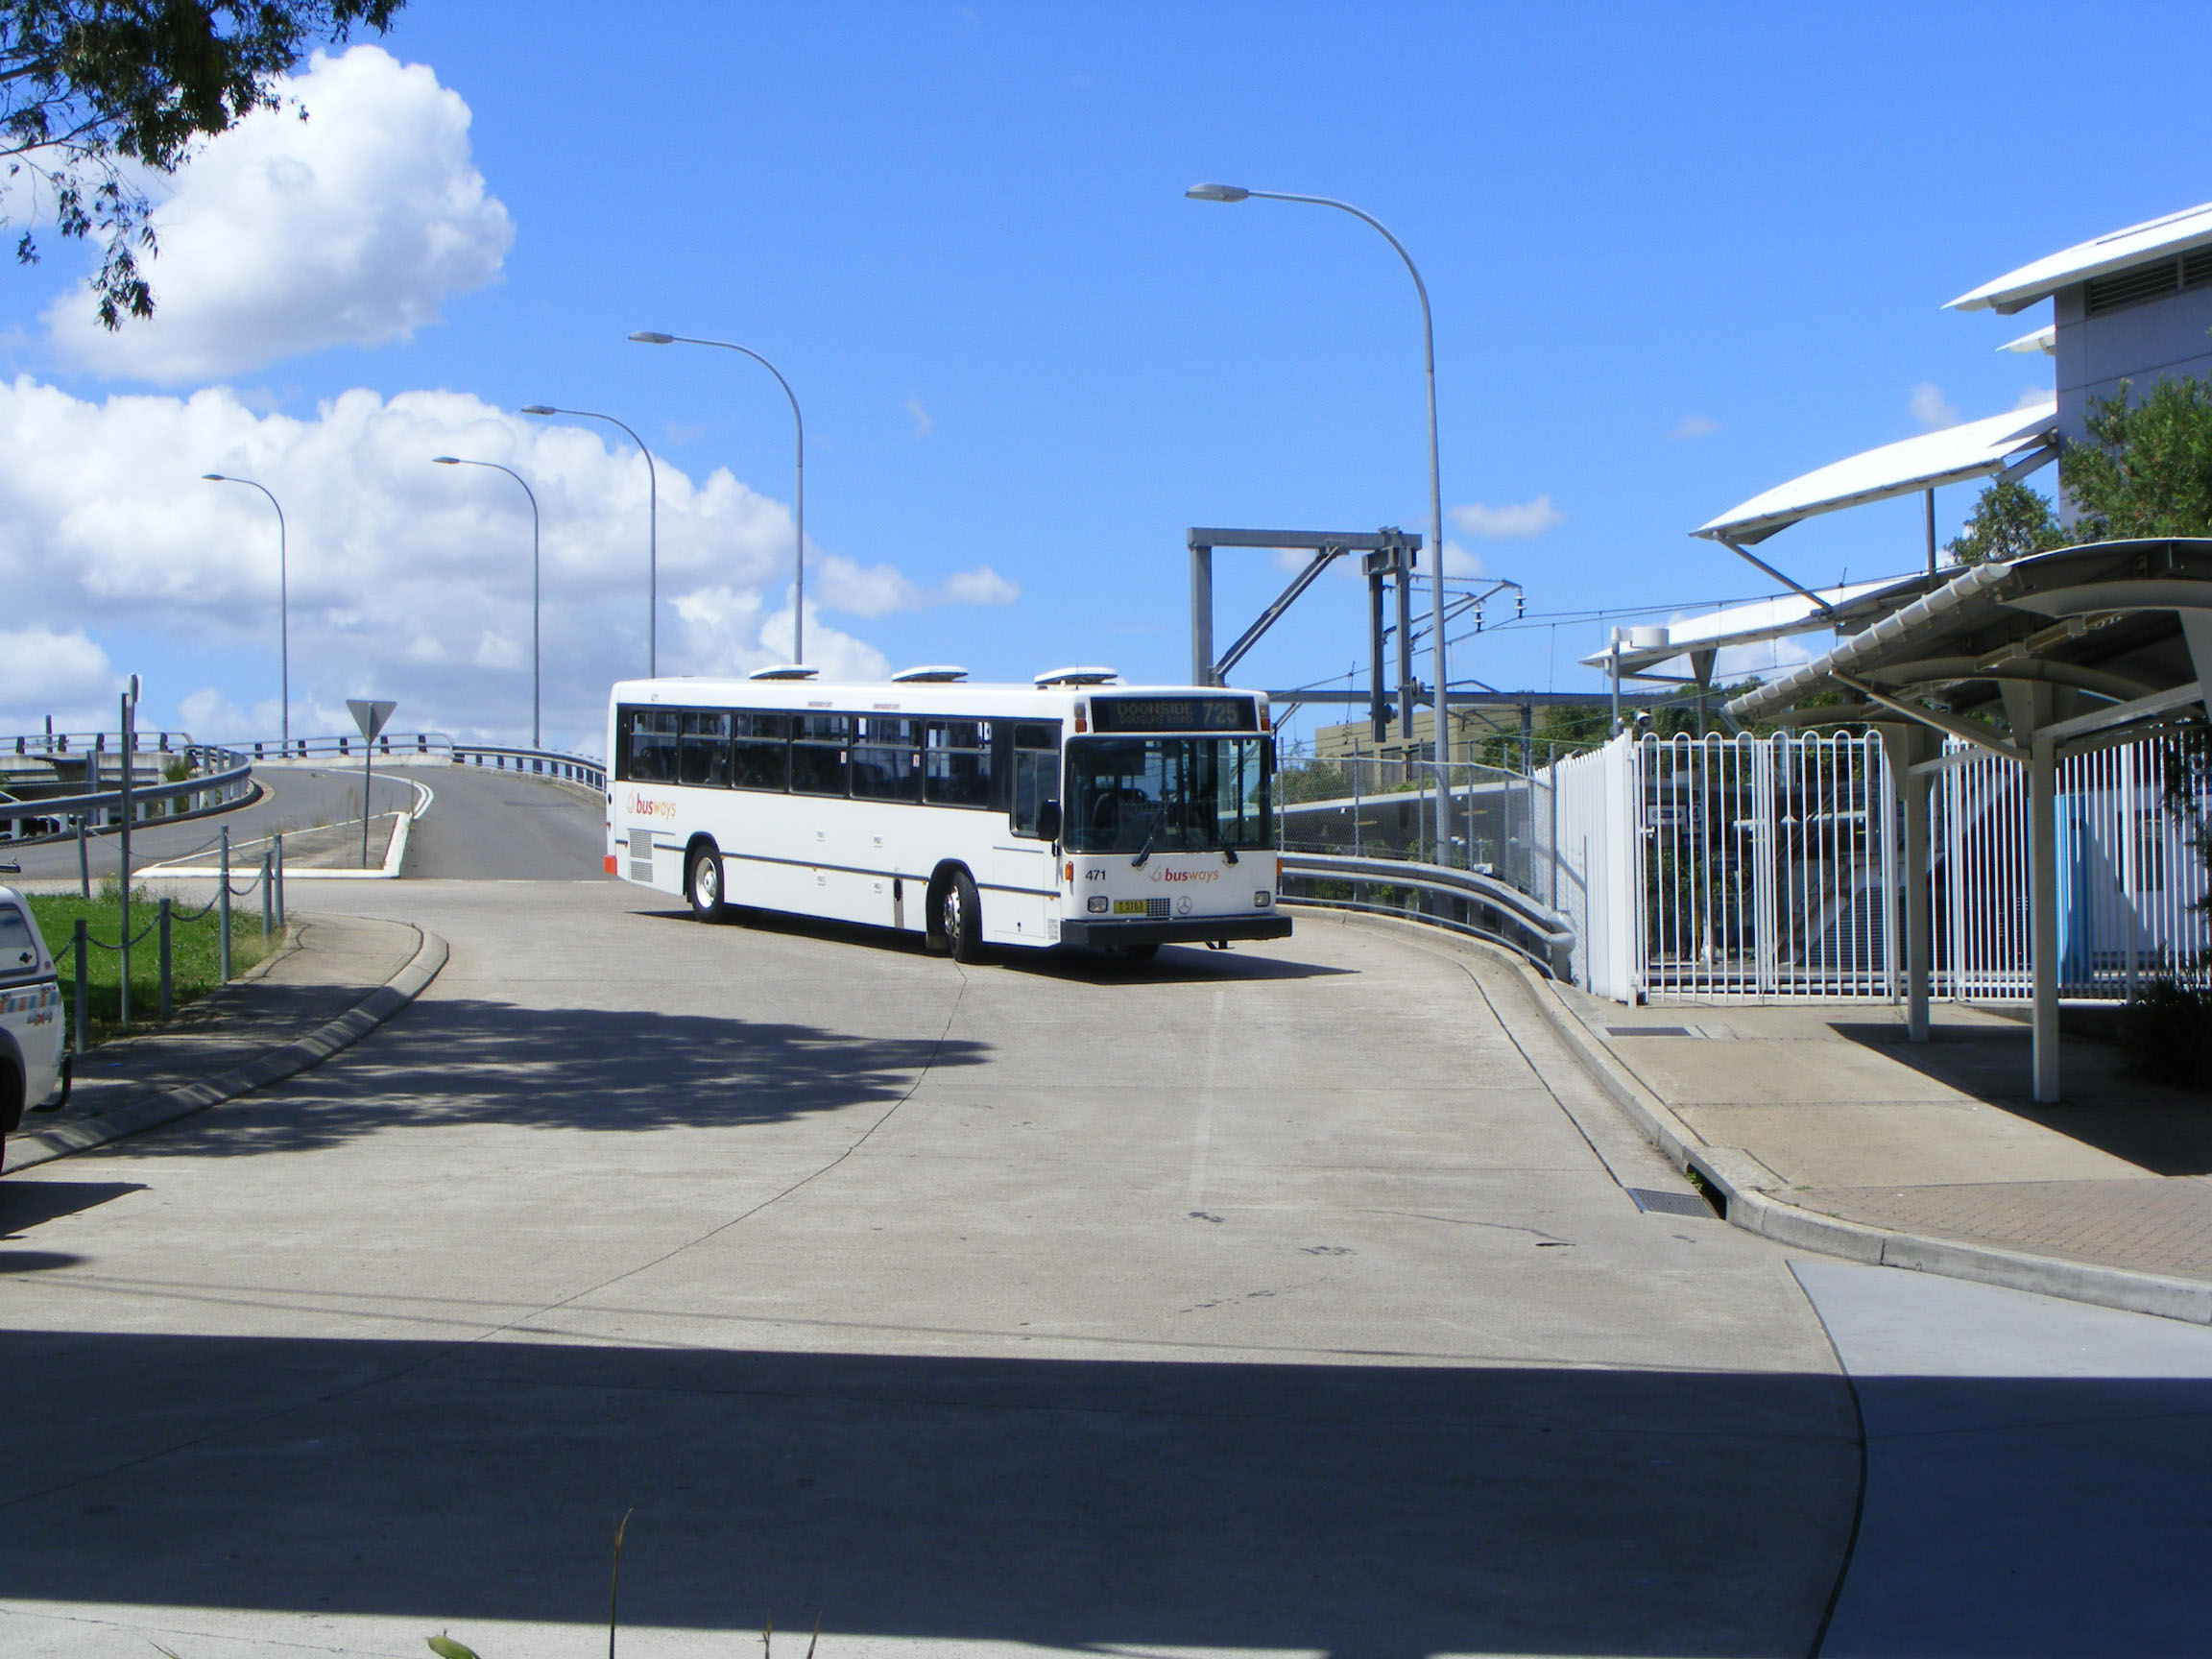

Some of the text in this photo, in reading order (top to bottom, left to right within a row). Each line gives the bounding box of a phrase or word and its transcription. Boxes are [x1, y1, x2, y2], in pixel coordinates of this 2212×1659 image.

[1117, 702, 1238, 724] DOONSIDE 725
[637, 792, 677, 822] busways
[1085, 869, 1106, 881] 471
[1165, 868, 1219, 883] busways
